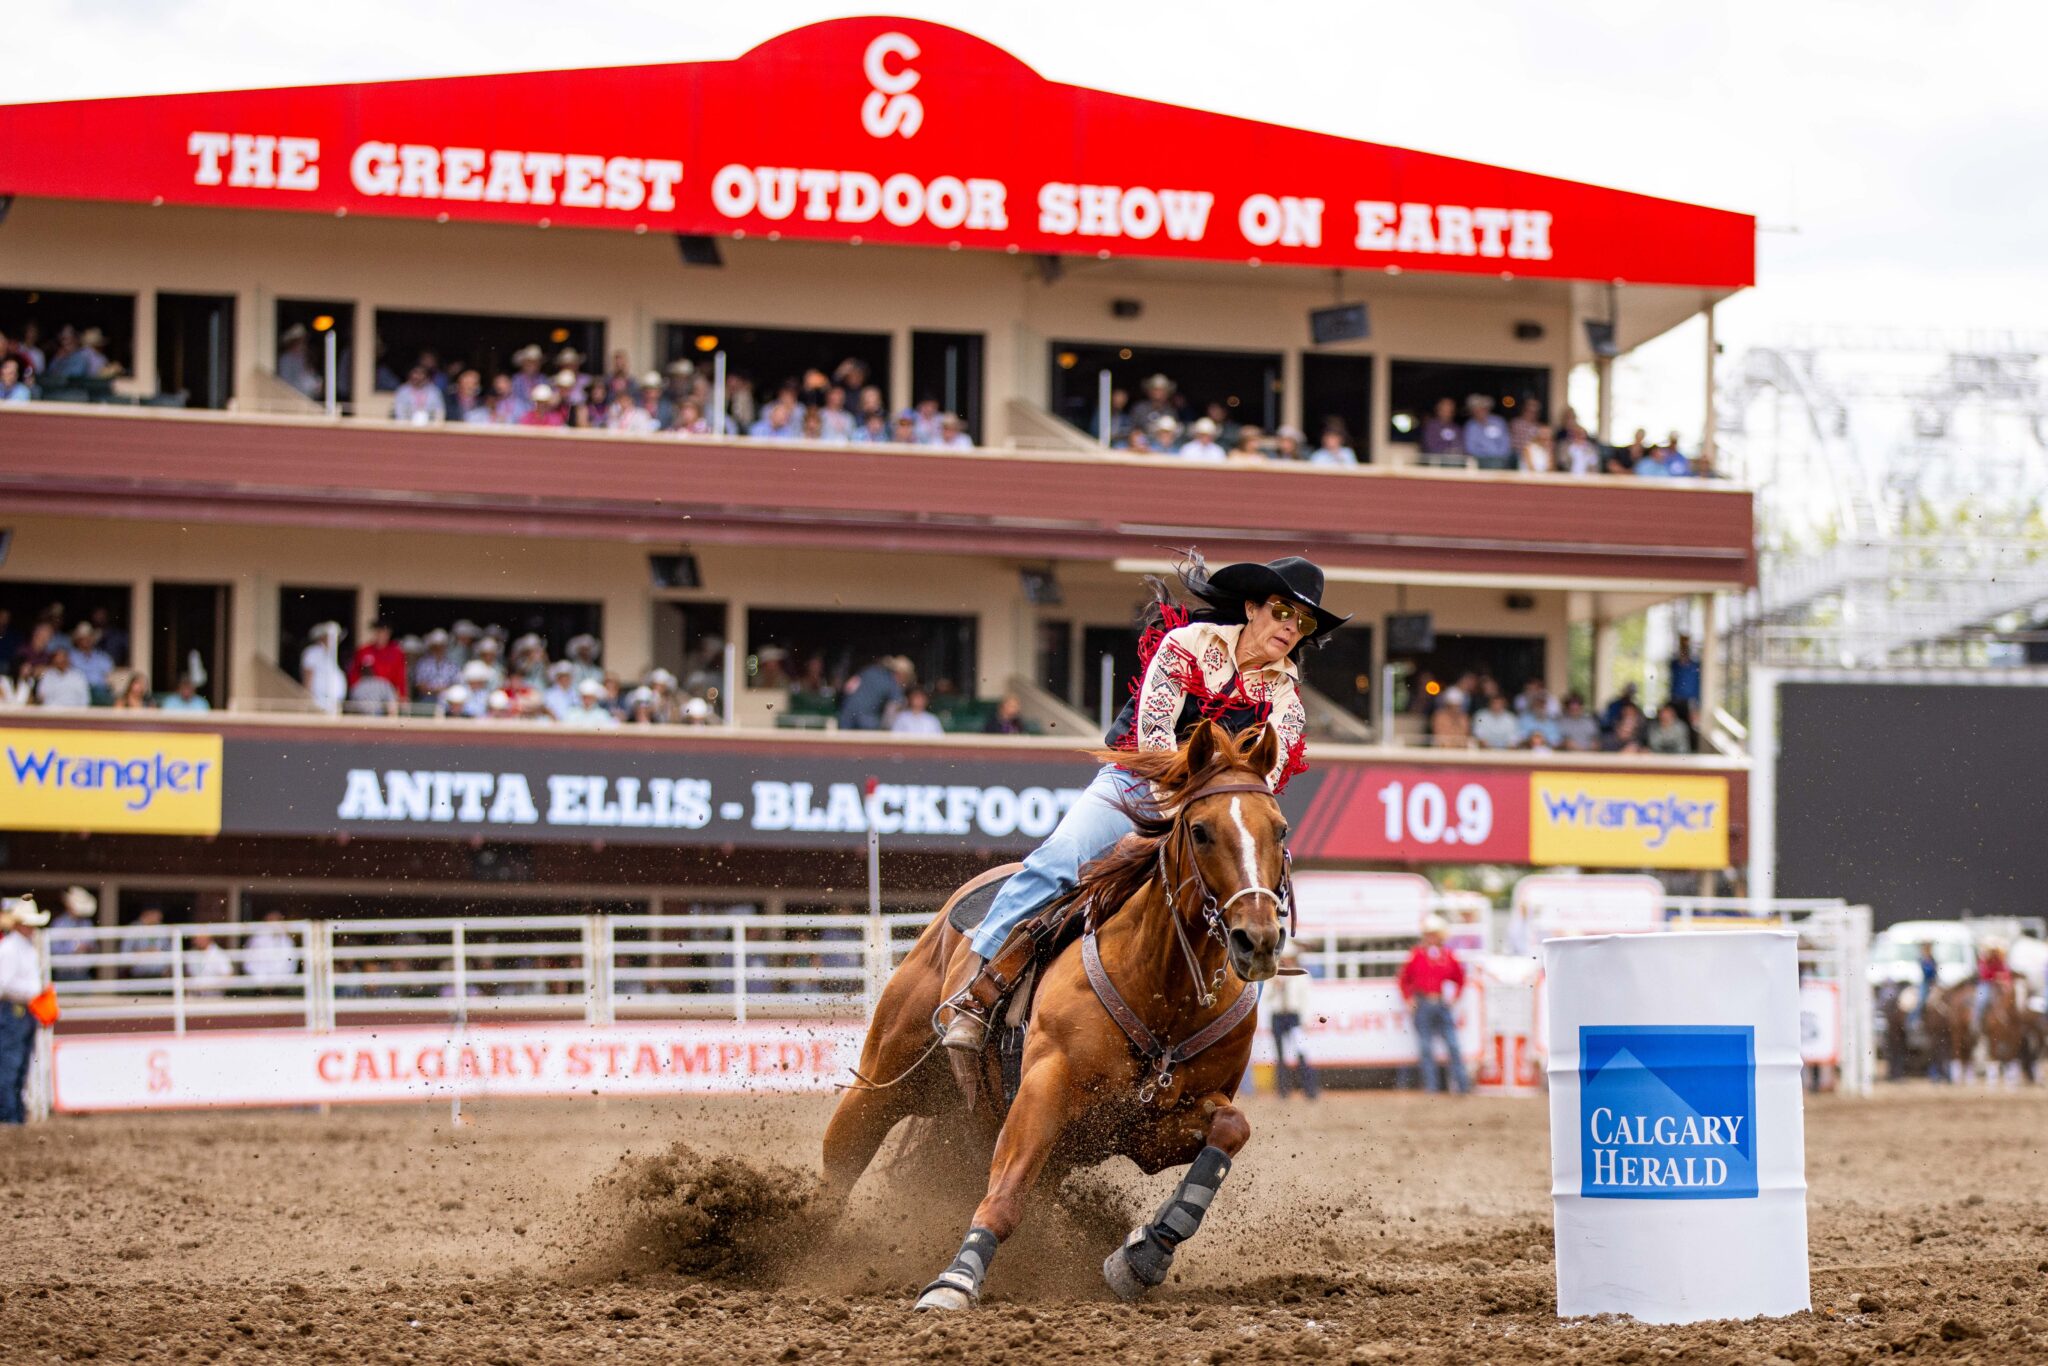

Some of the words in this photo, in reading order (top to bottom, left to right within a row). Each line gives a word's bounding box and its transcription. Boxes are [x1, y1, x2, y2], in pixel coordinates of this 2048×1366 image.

[188, 131, 321, 191] THE
[350, 141, 684, 212] GREATEST
[711, 164, 1009, 231] OUTDOOR
[1037, 182, 1215, 243] SHOW
[1238, 193, 1325, 249] ON
[1354, 200, 1553, 261] EARTH
[7, 747, 211, 811] Wrangler
[337, 769, 539, 825] ANITA
[547, 774, 712, 830] ELLIS
[1379, 781, 1493, 845] 10.9
[1542, 790, 1718, 849] Wrangler
[316, 1047, 546, 1084] CALGARY
[566, 1041, 838, 1077] STAMPEDE
[1591, 1106, 1744, 1146] CALGARY
[1592, 1148, 1729, 1187] HERALD
